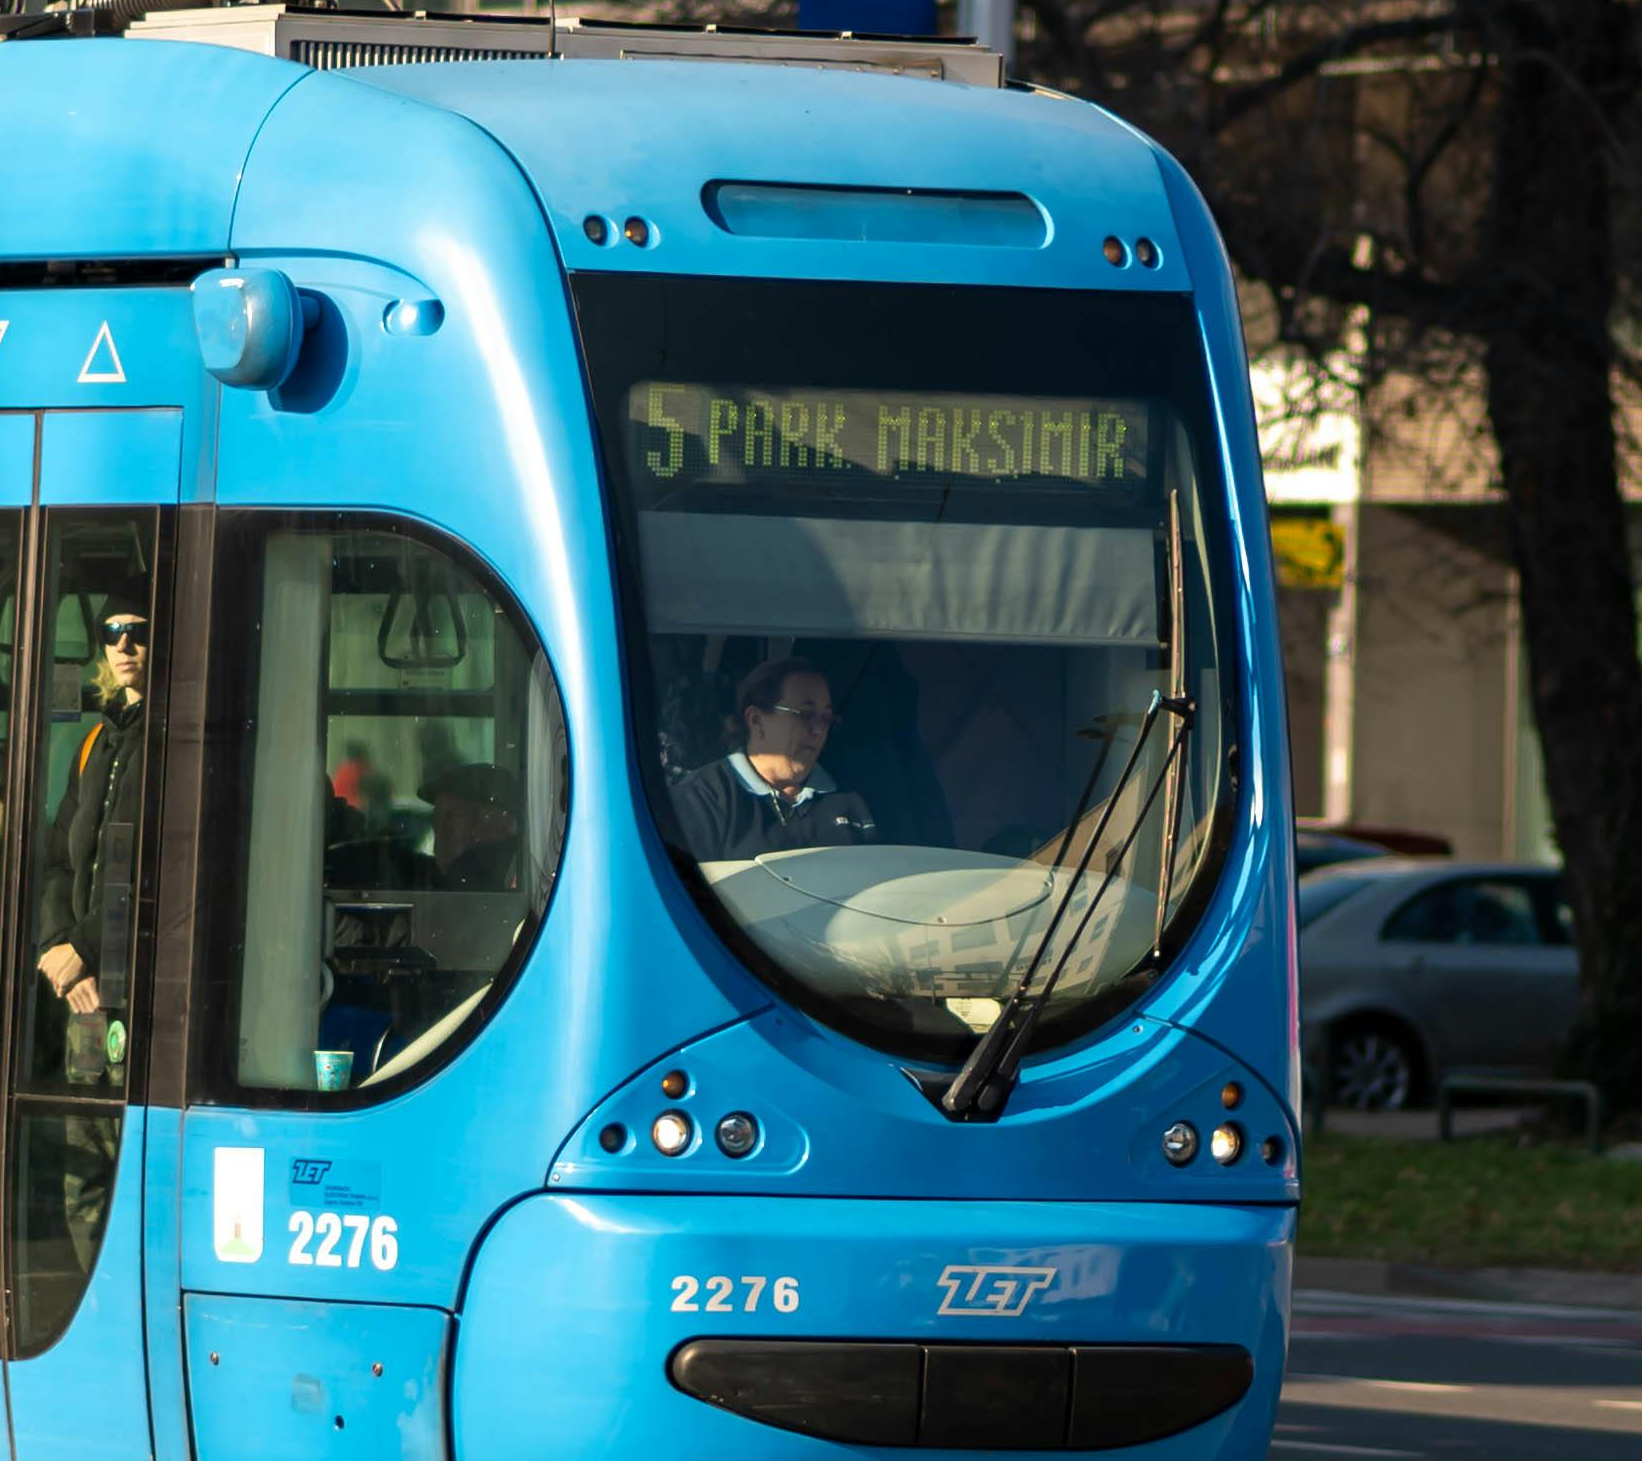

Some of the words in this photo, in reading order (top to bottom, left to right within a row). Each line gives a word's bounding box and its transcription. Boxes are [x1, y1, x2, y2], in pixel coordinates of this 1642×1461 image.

[647, 383, 685, 477] 5
[709, 399, 847, 469] PARK
[877, 405, 1128, 479] MAKSIMIR
[292, 1159, 333, 1185] ZET
[288, 1210, 398, 1271] 2276
[671, 1275, 800, 1313] 2276
[936, 1265, 1058, 1316] ZET
